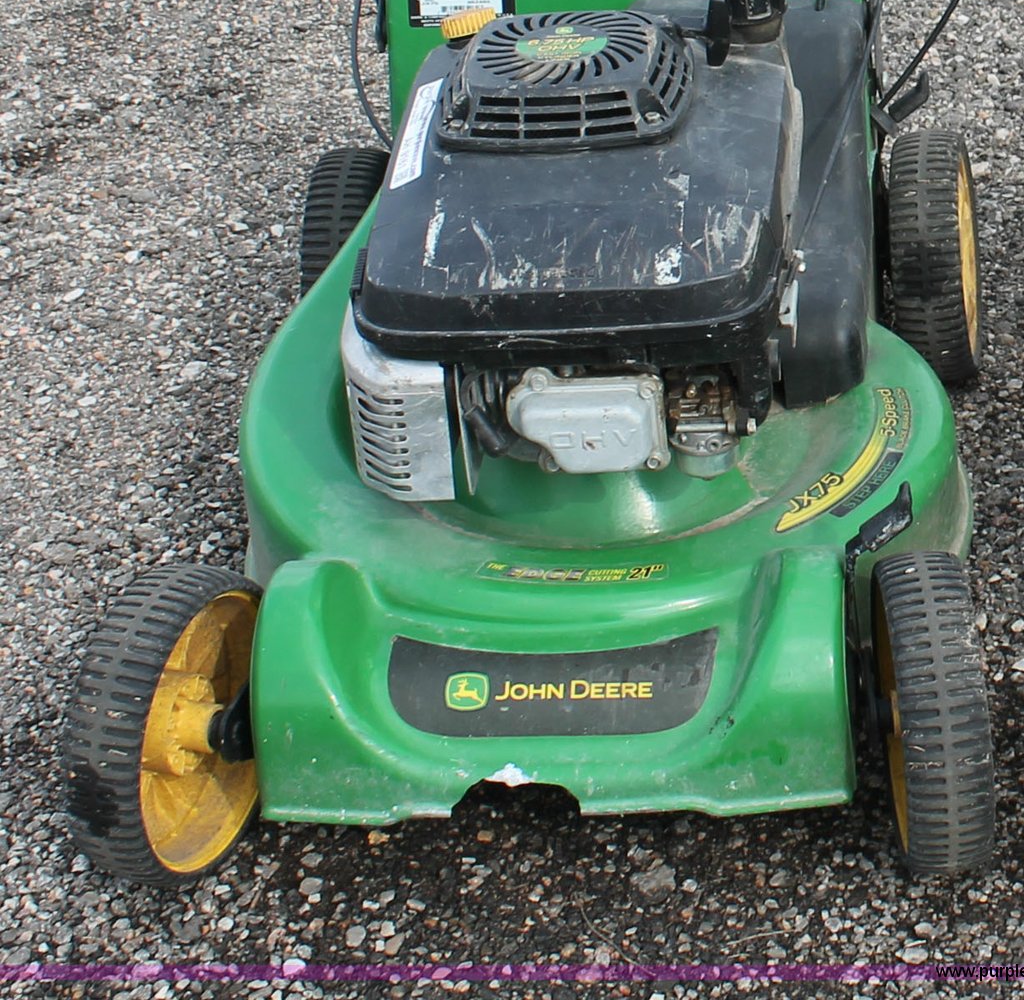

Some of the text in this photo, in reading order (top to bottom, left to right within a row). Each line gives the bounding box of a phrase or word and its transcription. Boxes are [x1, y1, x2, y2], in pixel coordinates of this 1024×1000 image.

[487, 562, 507, 570] THE
[588, 568, 626, 576] CUTTING
[495, 679, 653, 701] JOHN DEERE
